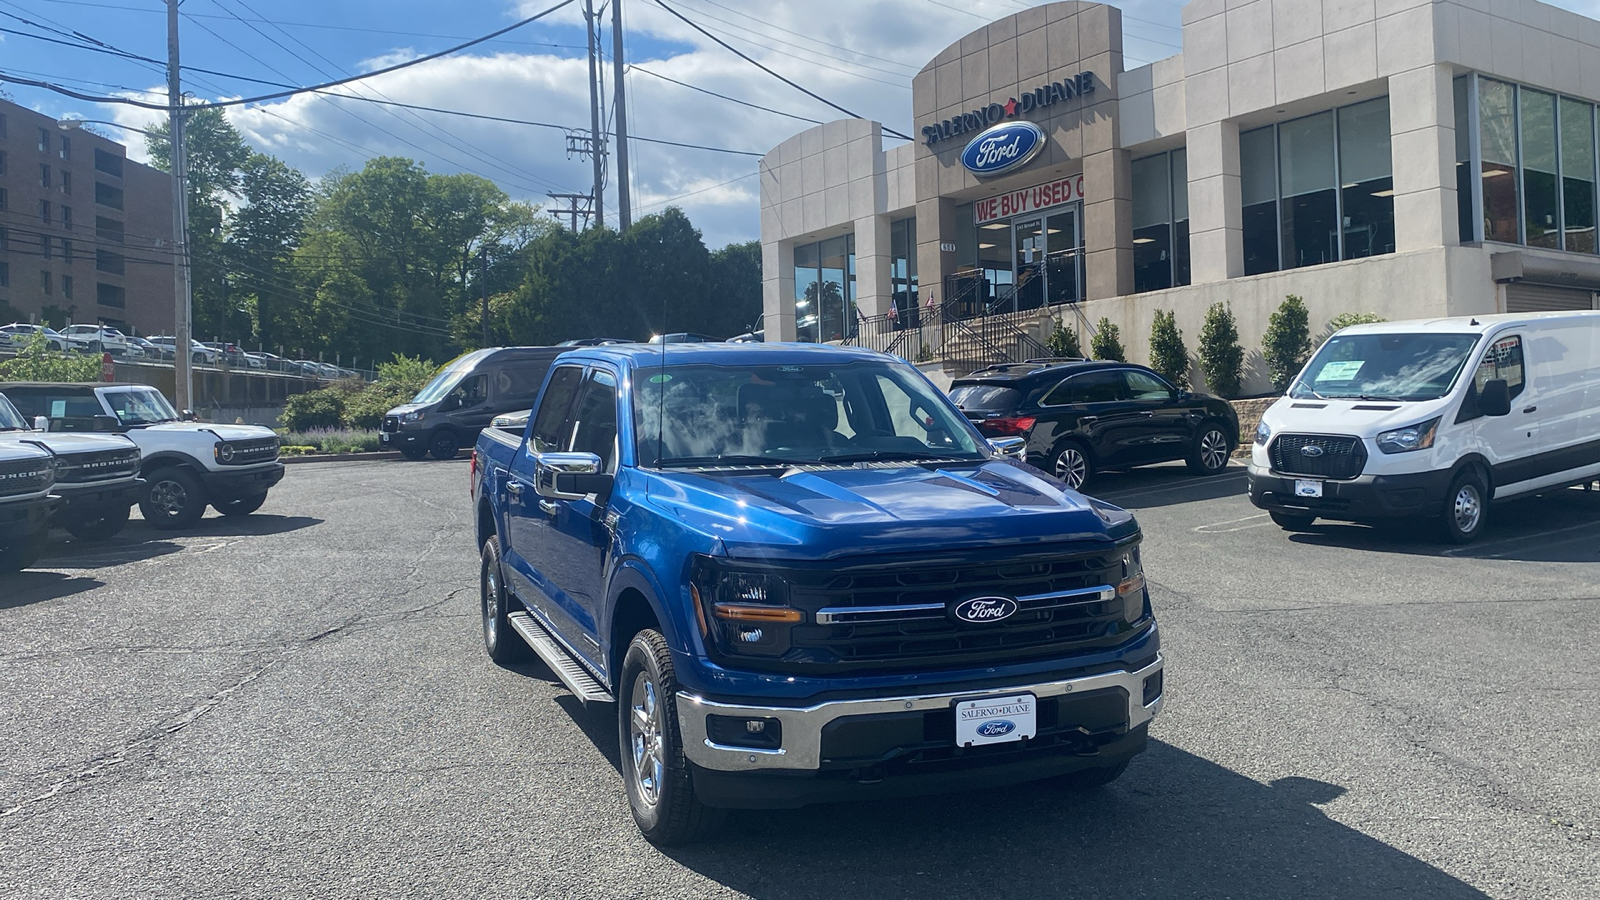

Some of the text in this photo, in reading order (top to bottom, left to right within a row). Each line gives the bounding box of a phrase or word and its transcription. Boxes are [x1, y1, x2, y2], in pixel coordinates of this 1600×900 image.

[921, 71, 1095, 145] SALERNO DUANE
[975, 133, 1021, 167] Ford
[976, 198, 998, 222] WE
[1001, 190, 1029, 216] BUY
[1032, 180, 1072, 209] USED
[83, 459, 129, 469] BRONCO
[967, 600, 1005, 619] Ford
[961, 703, 1030, 718] SALERNO DUANE
[983, 721, 1008, 735] Ford
